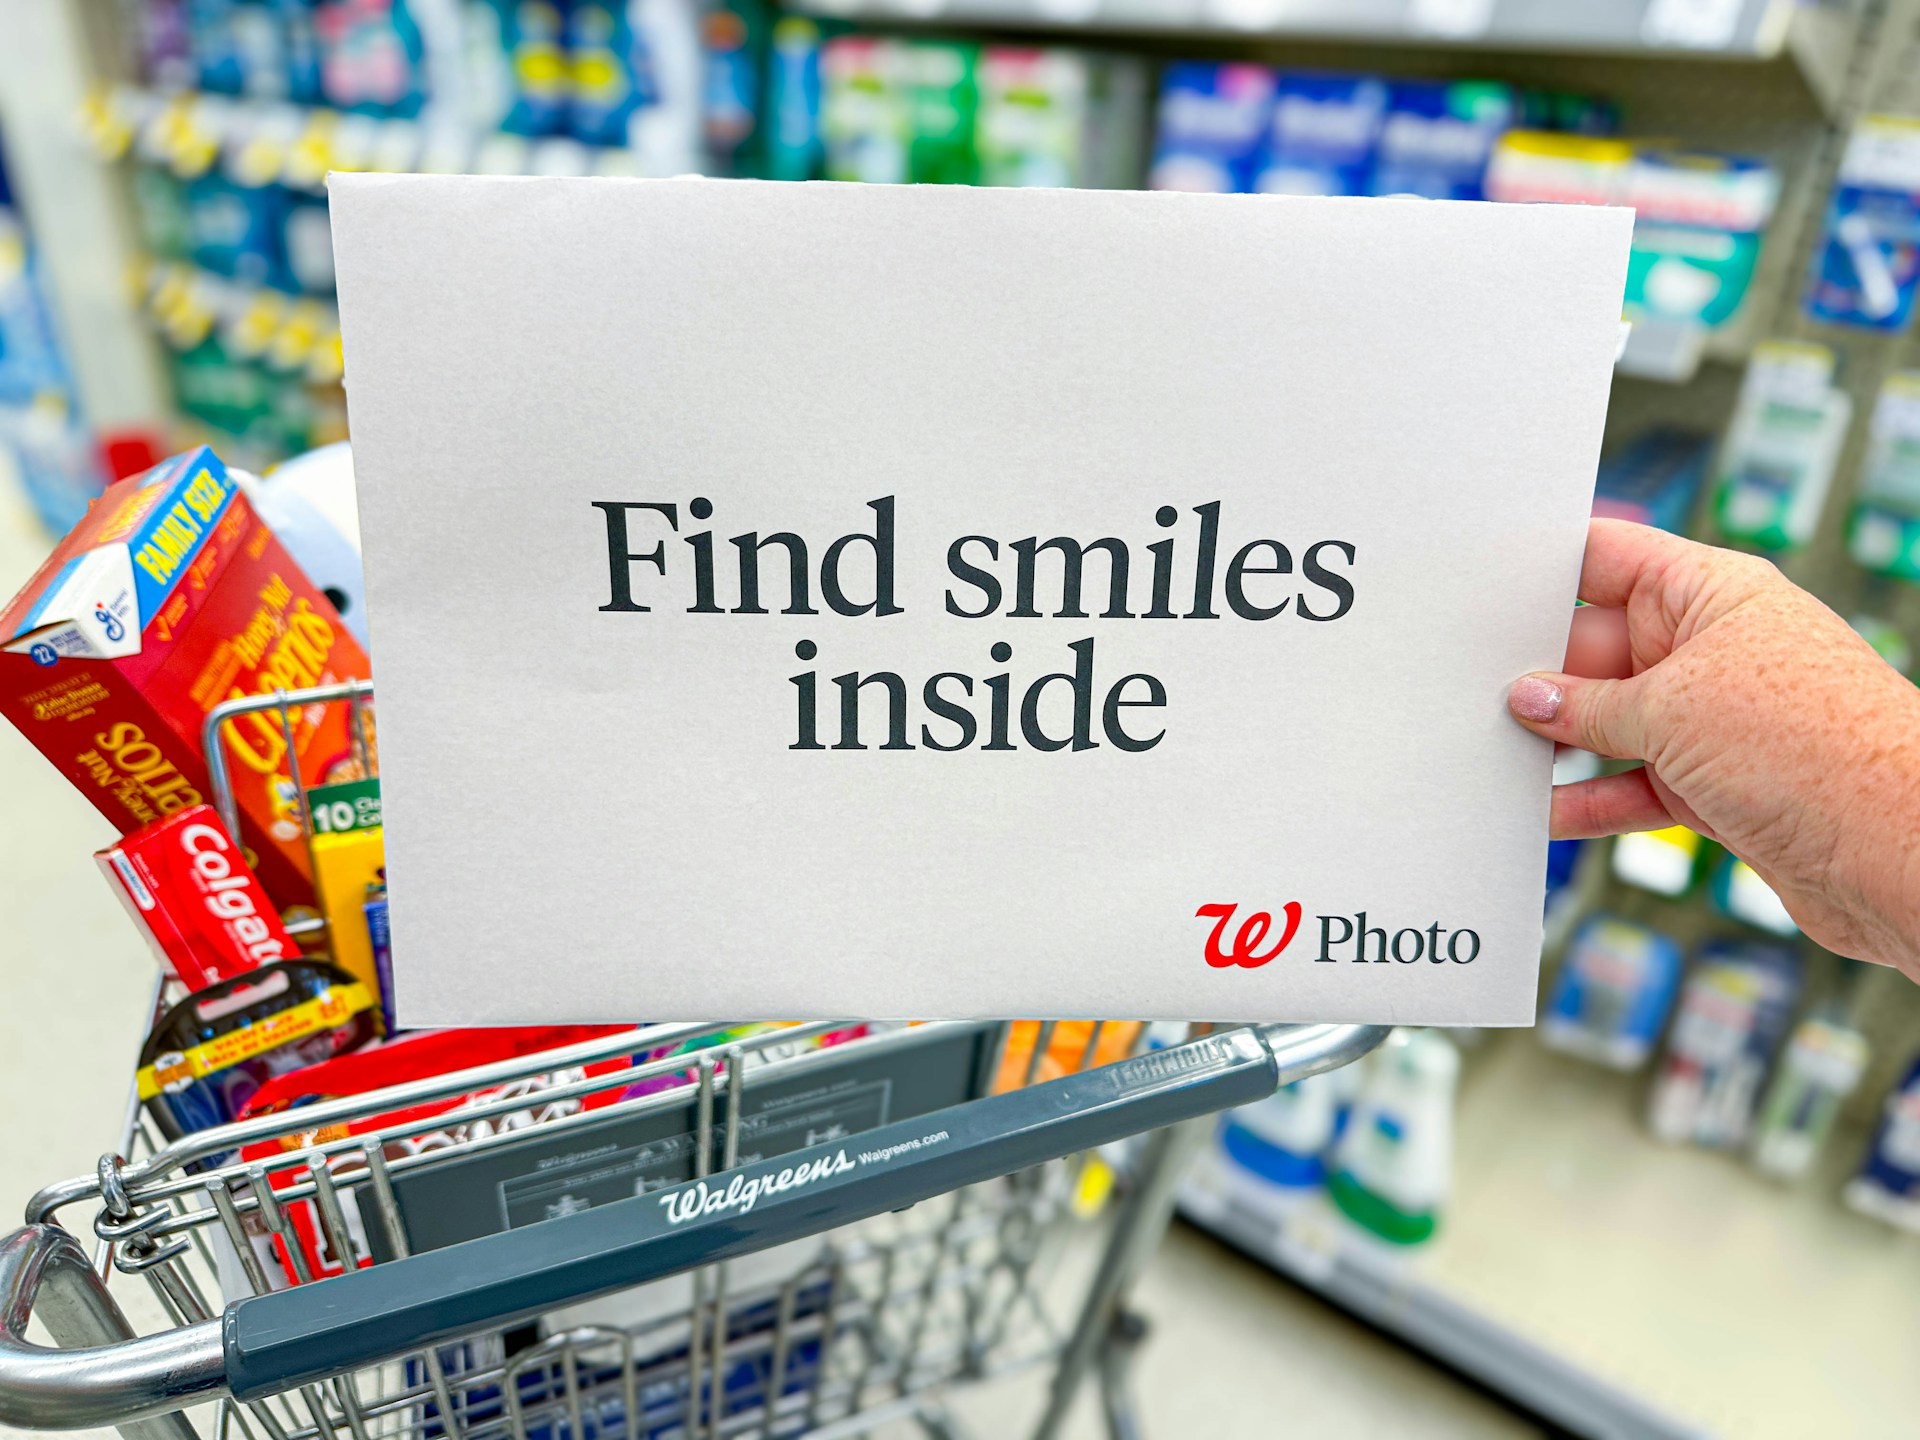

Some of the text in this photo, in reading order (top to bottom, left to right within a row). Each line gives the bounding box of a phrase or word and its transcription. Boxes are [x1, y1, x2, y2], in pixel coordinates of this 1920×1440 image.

[136, 501, 203, 585] FAMILY
[184, 468, 228, 522] SIZE
[592, 495, 1355, 621] Find smiles
[233, 607, 284, 669] Honey
[789, 637, 1166, 752] inside
[95, 722, 204, 815] erios
[313, 800, 355, 832] 10
[1315, 912, 1480, 964] Photo
[659, 1148, 856, 1226] Walgreens
[858, 1130, 950, 1167] Walgreens.com
